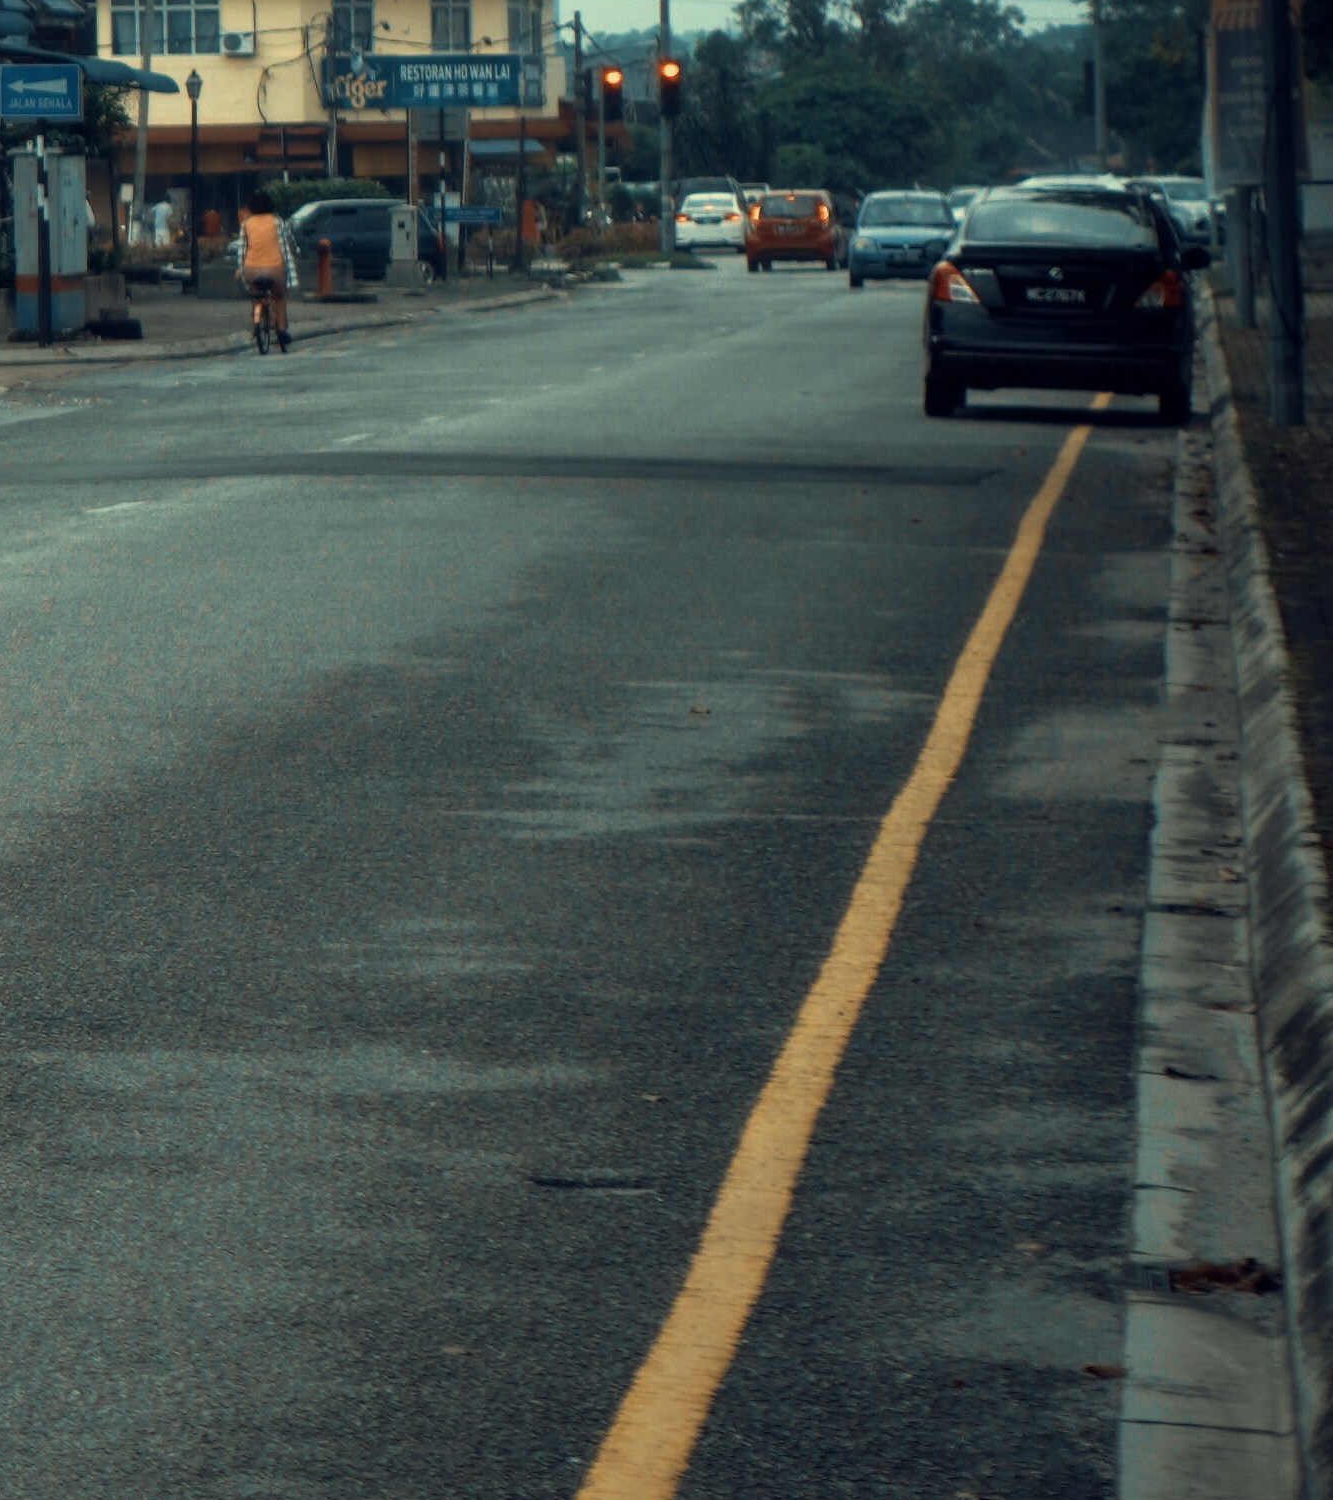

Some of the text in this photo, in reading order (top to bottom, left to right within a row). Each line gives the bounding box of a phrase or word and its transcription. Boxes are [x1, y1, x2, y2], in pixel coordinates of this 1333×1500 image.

[400, 63, 453, 82] RESTORAN
[469, 63, 493, 81] WAN
[494, 63, 510, 80] LAI
[9, 96, 36, 109] JALAN
